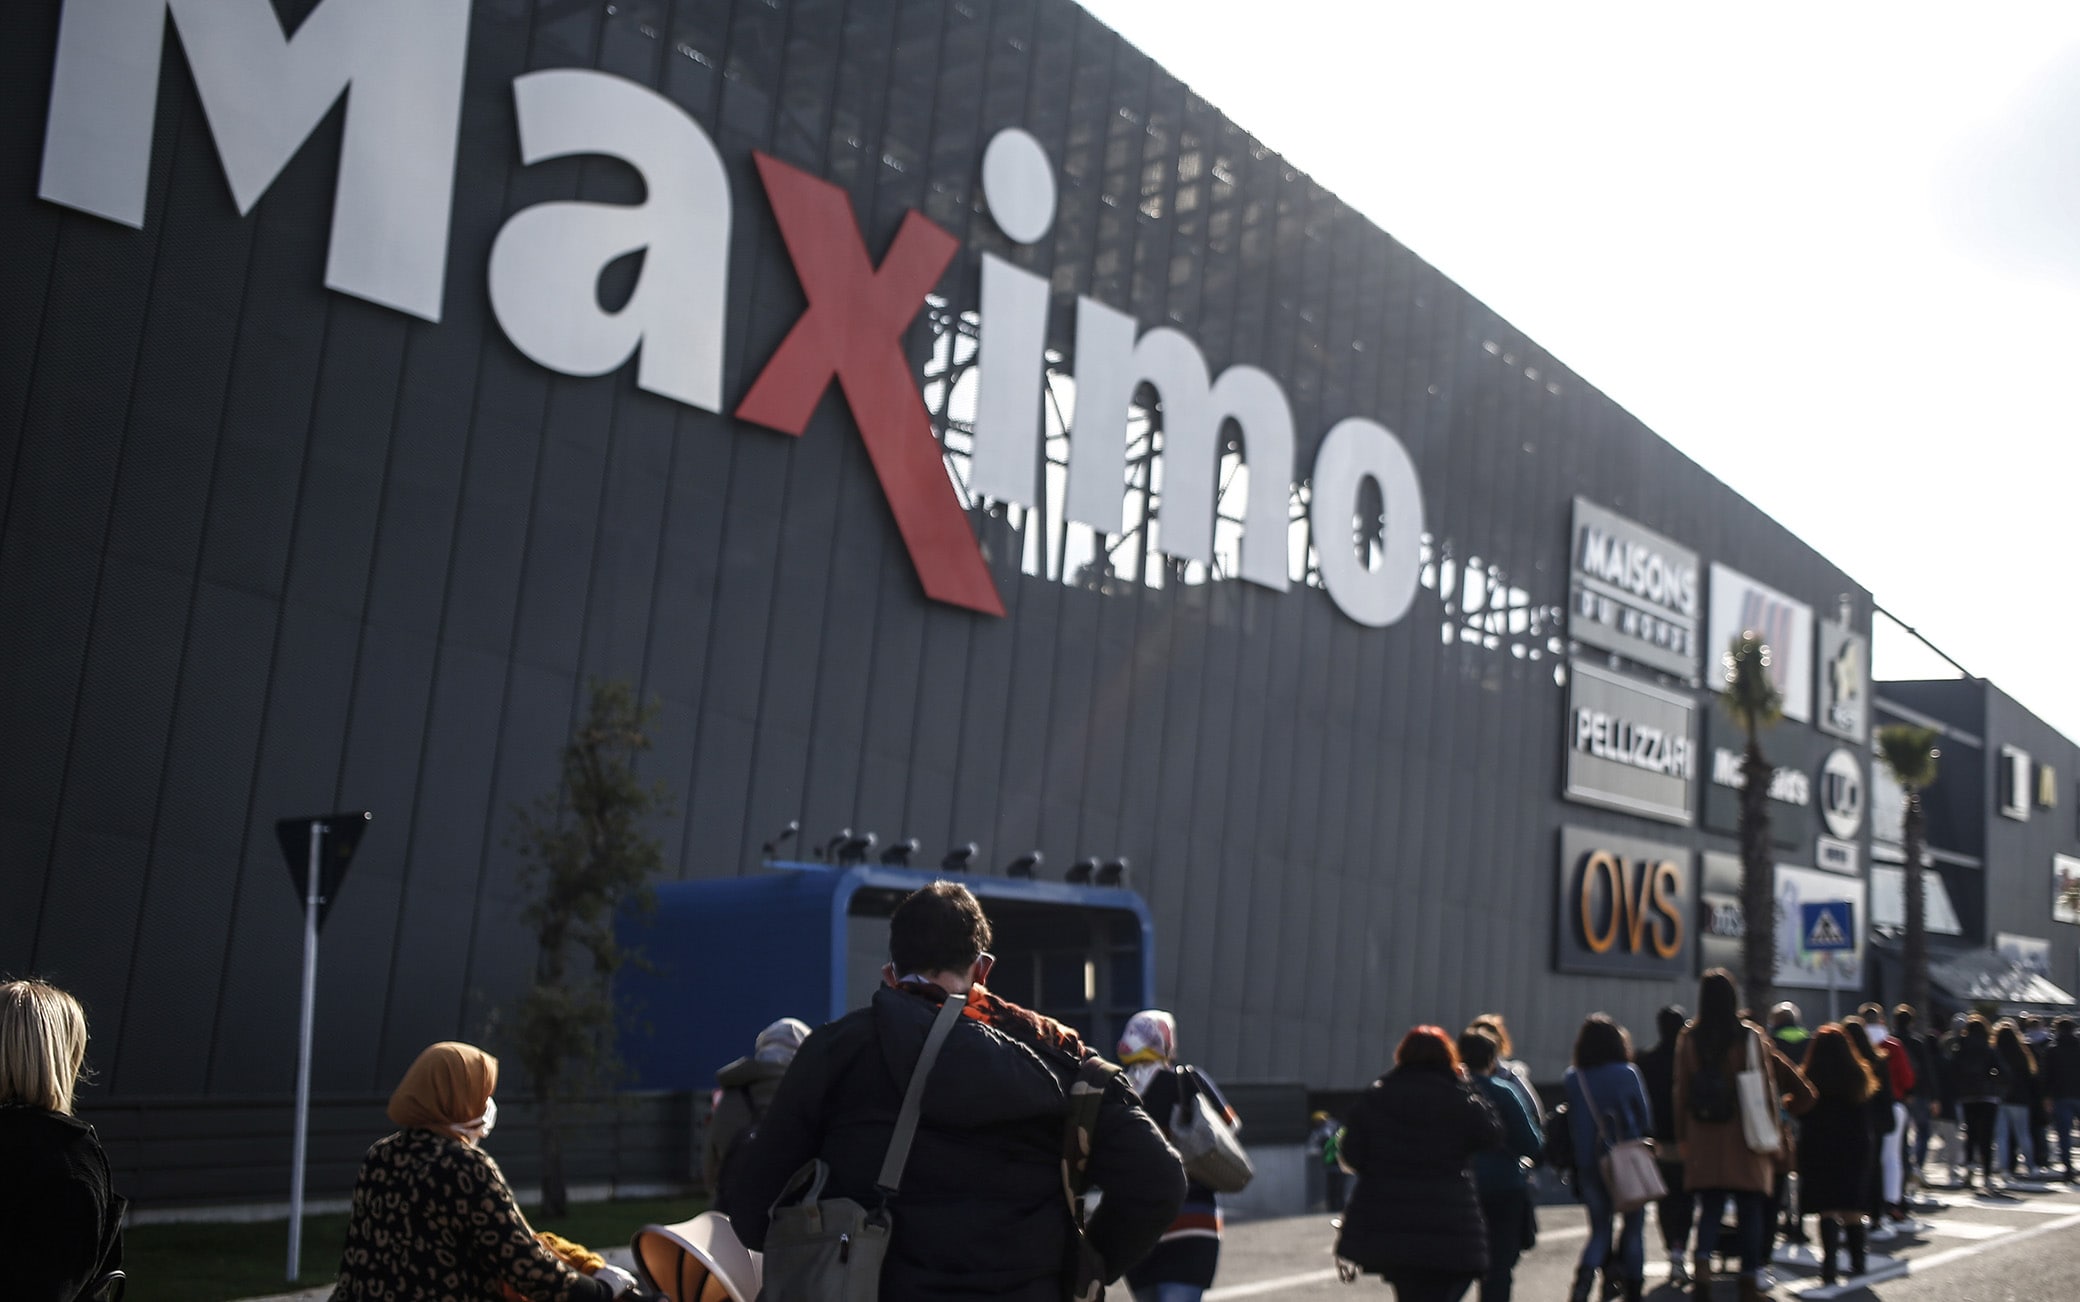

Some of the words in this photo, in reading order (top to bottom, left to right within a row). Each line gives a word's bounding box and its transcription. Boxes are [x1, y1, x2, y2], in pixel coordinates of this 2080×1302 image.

[37, 0, 1425, 628] Maximo
[1583, 527, 1696, 616] MAISONS
[1577, 708, 1697, 780] PELLIZZARI
[1581, 849, 1685, 959] OVS
